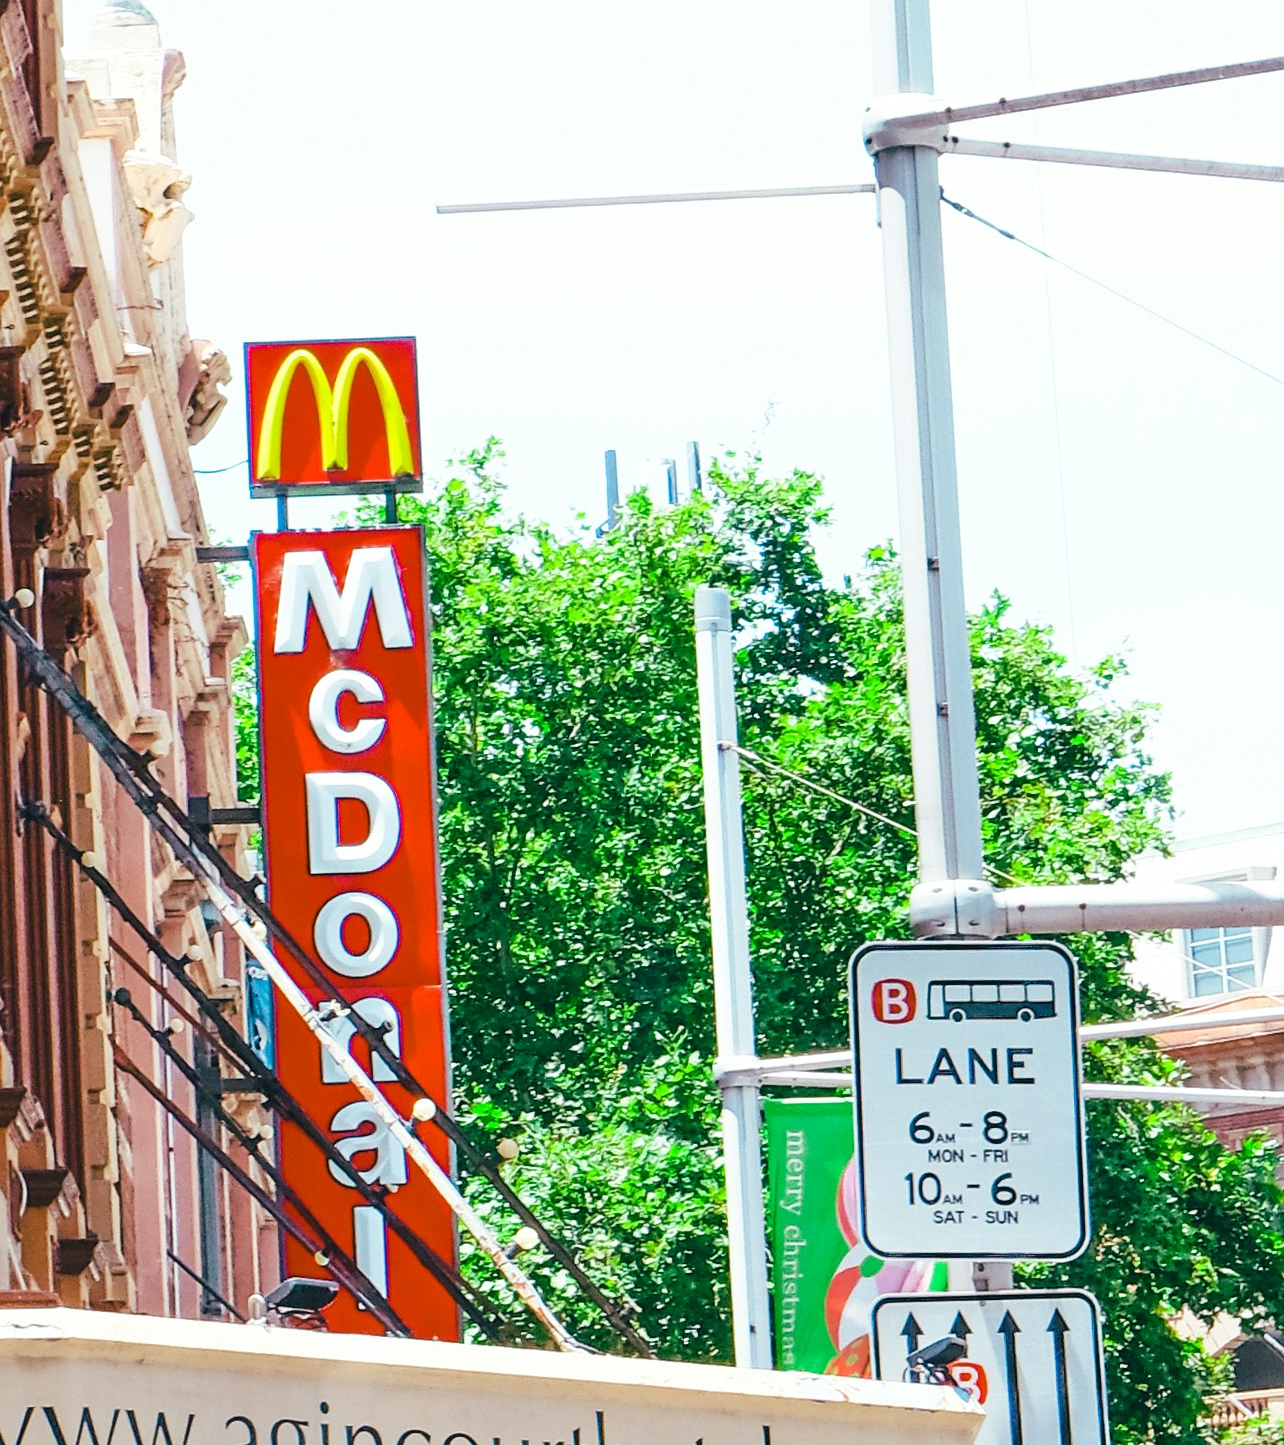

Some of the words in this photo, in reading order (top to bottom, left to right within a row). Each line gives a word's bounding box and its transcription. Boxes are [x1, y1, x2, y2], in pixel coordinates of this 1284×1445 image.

[882, 983, 910, 1020] B
[895, 1047, 1036, 1086] LANE
[909, 1112, 956, 1144] 6AM
[982, 1111, 1030, 1144] 8PM
[780, 1130, 807, 1216] merry
[928, 1149, 964, 1164] MON
[983, 1149, 1009, 1164] FRI
[904, 1172, 963, 1206] 10AM
[990, 1171, 1040, 1206] 6PM
[932, 1211, 963, 1225] SAT
[986, 1210, 1019, 1225] SUN
[781, 1225, 807, 1366] christmas
